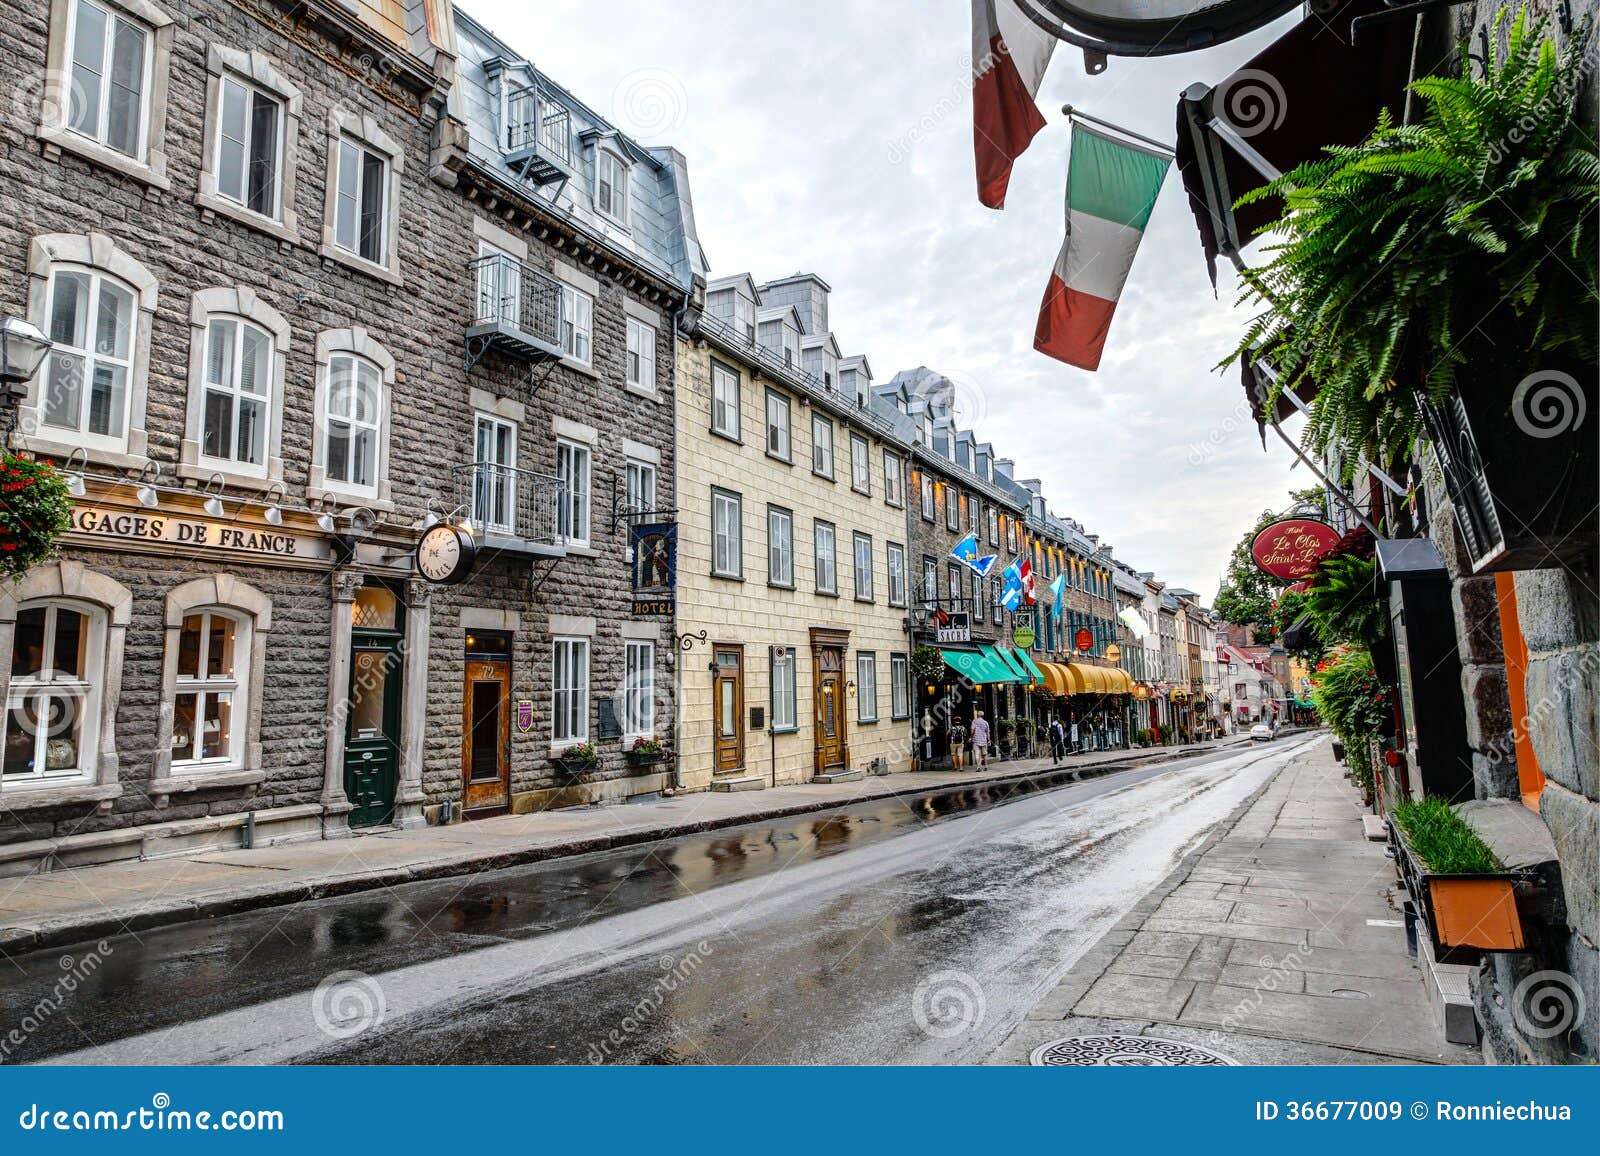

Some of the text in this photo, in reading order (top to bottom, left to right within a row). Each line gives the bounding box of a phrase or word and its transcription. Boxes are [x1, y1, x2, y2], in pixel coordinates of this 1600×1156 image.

[177, 523, 207, 543] DE
[219, 528, 296, 554] FRANCE
[1273, 534, 1321, 550] Le Clos
[1262, 548, 1316, 565] Saint-L
[634, 602, 673, 614] HOTEL
[481, 665, 495, 679] 72
